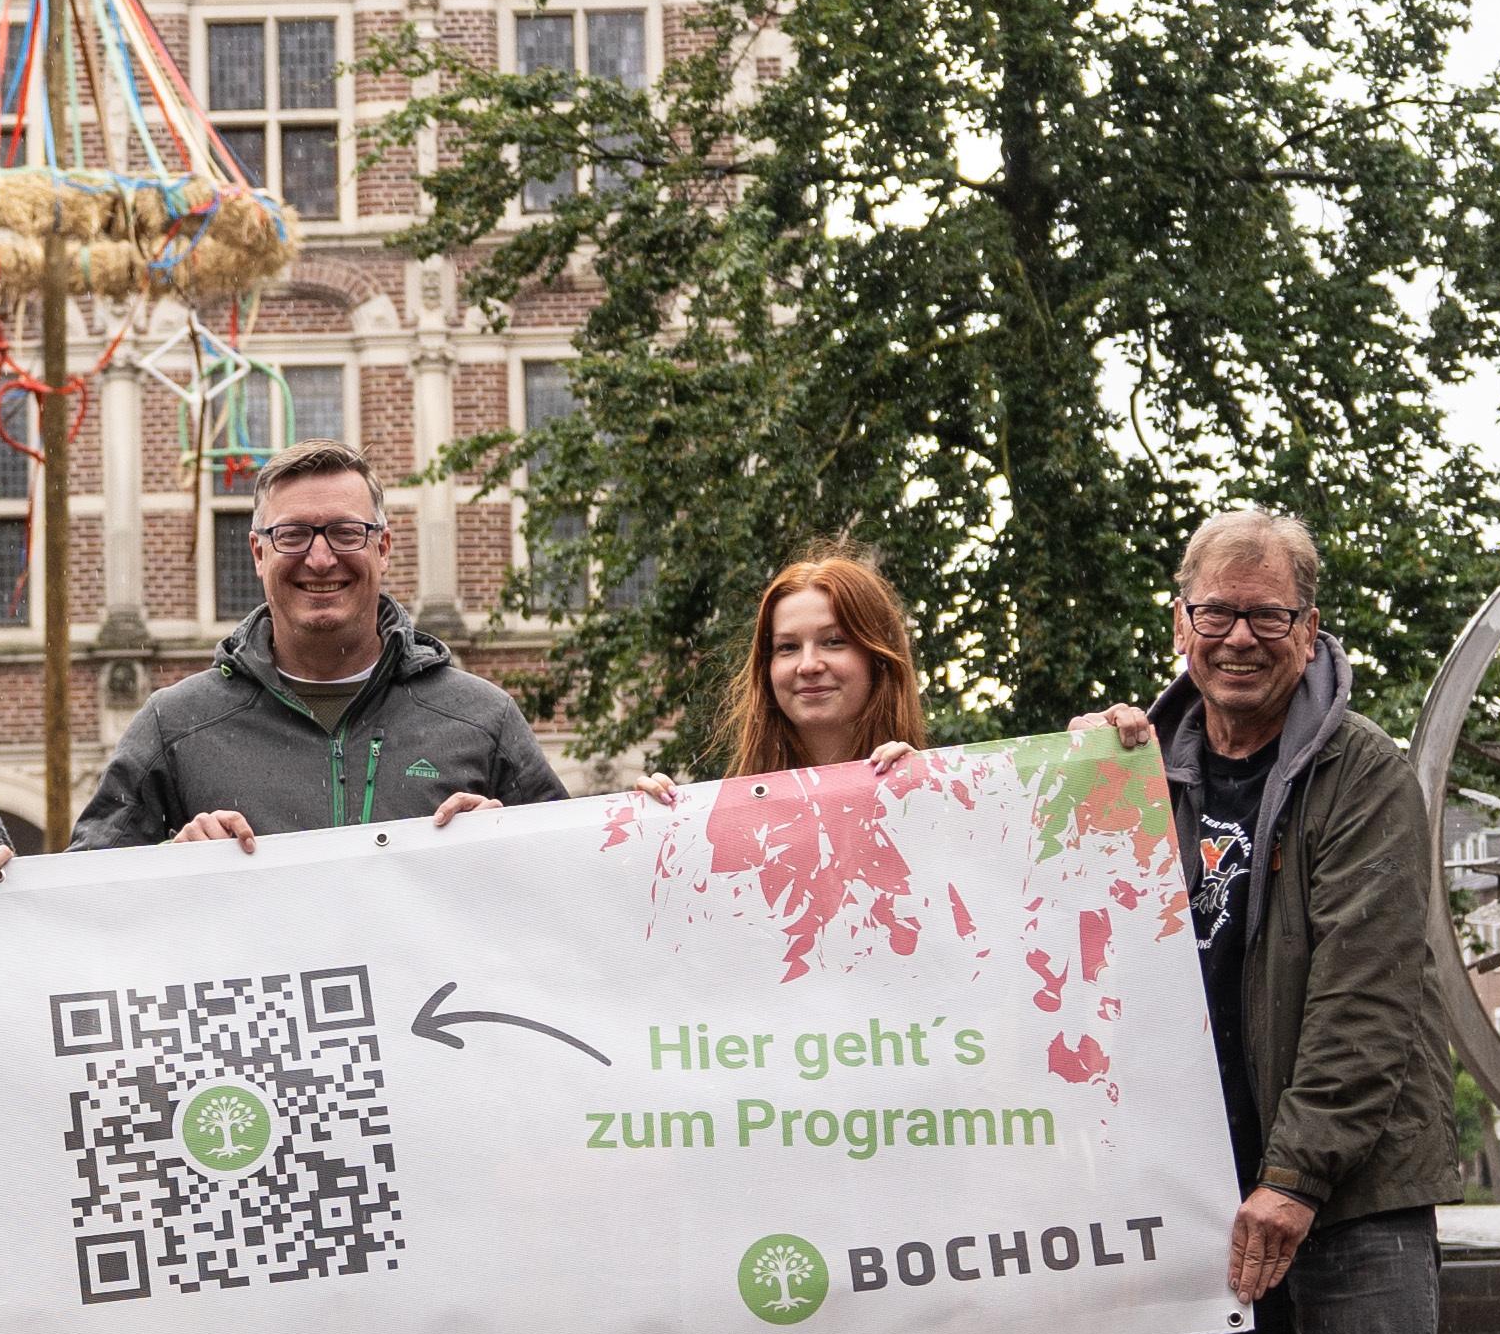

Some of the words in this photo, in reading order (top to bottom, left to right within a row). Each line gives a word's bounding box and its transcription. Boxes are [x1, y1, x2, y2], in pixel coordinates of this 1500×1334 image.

[649, 1023, 774, 1070] Hier
[585, 1110, 715, 1149] zum
[737, 1098, 1056, 1160] Programm
[848, 1216, 1164, 1293] BOCHOLT
